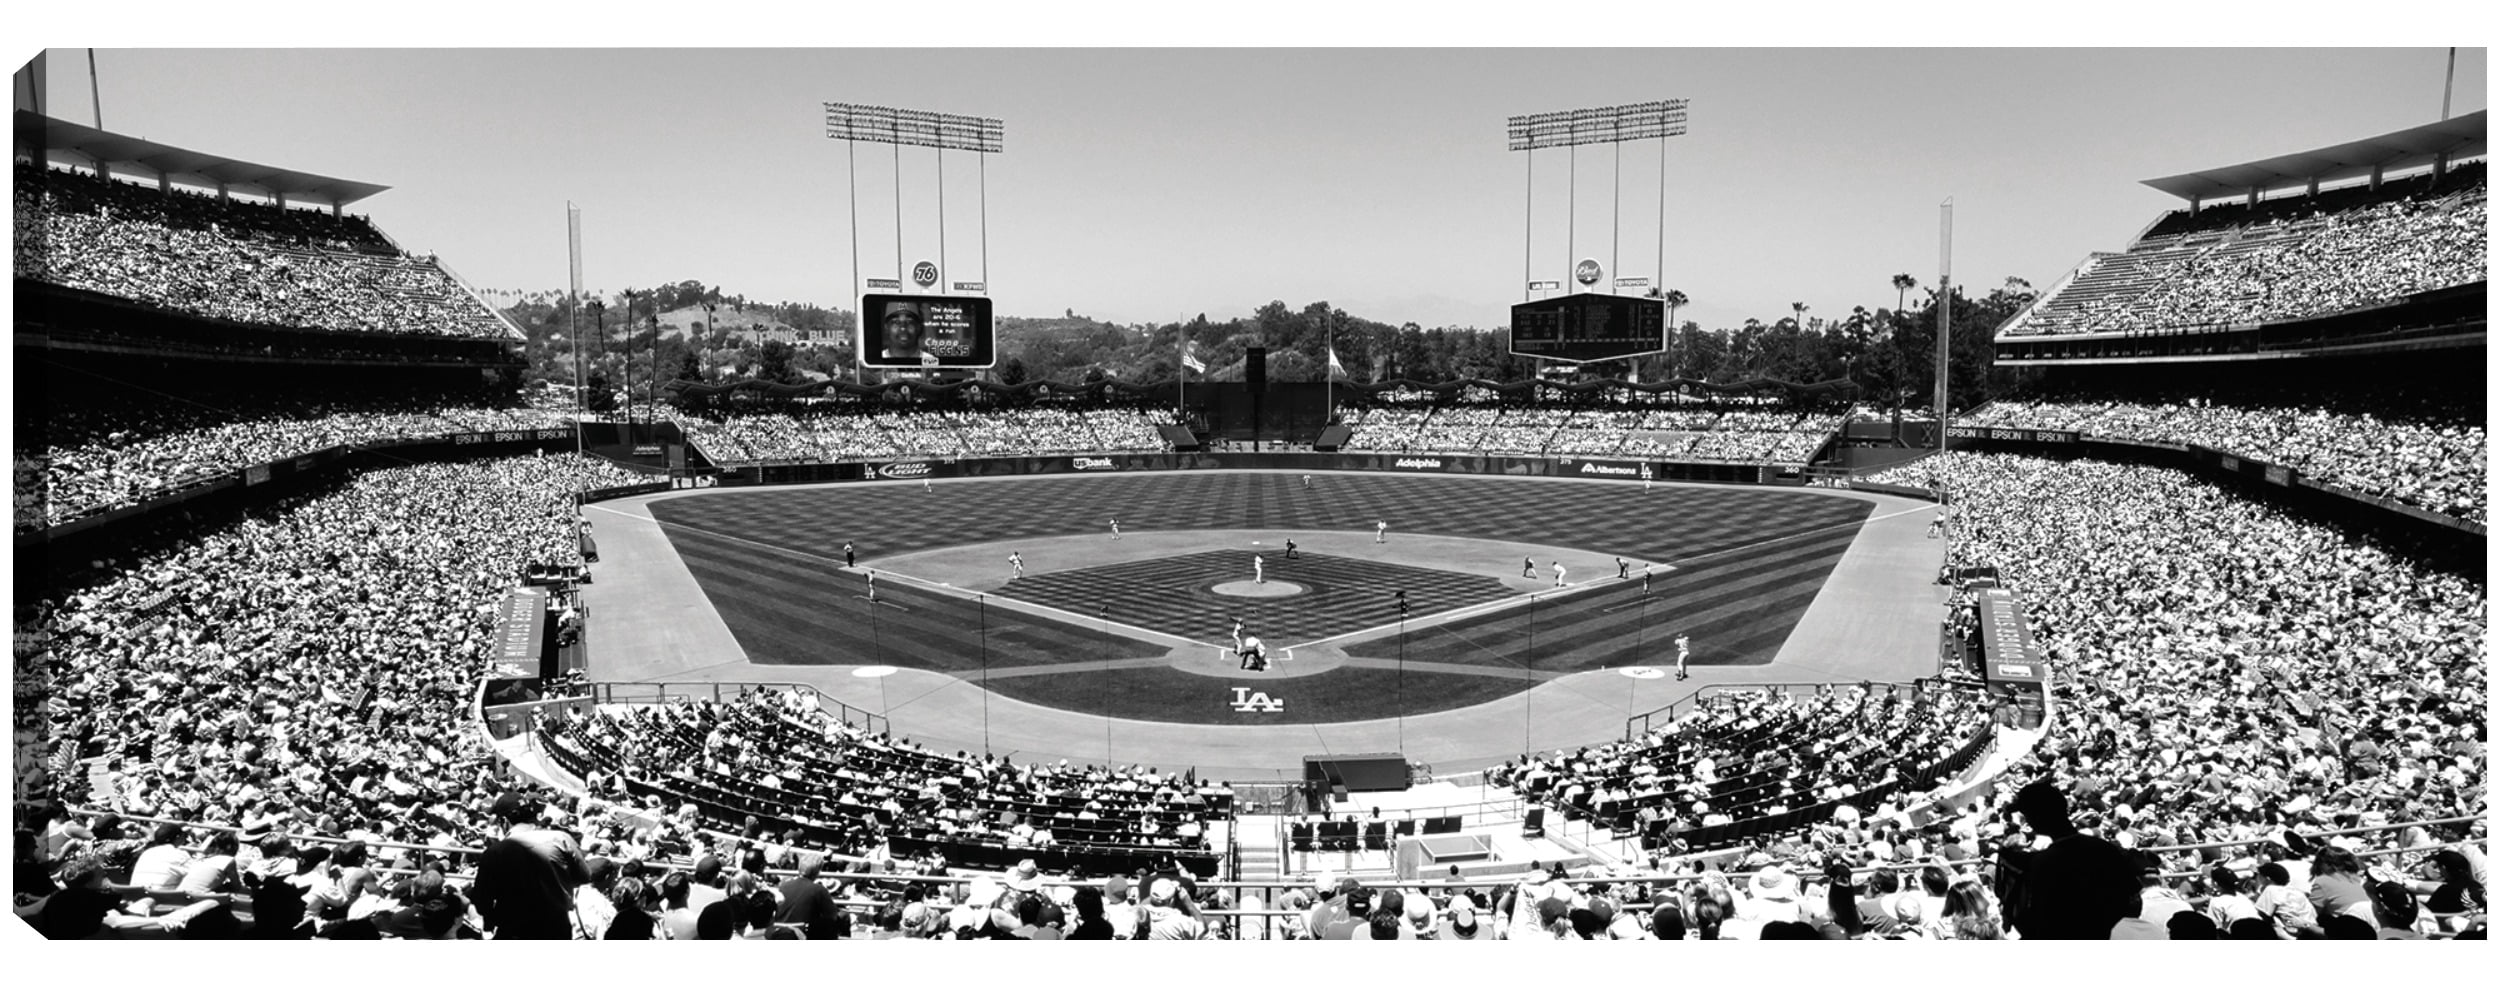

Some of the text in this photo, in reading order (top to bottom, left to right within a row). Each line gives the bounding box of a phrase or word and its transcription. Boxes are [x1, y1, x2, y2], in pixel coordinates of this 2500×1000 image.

[916, 267, 934, 280] 76
[809, 330, 846, 341] BLUE
[495, 432, 523, 442] EPSON
[537, 429, 568, 440] EPSON
[1946, 427, 1976, 438] EPSON
[1991, 429, 2022, 440] EPSON
[2036, 431, 2066, 442] EPSON
[455, 434, 482, 445] EPSON
[1396, 458, 1441, 469] Adelphia
[1784, 466, 1800, 474] 360
[1229, 687, 1284, 712] LA
